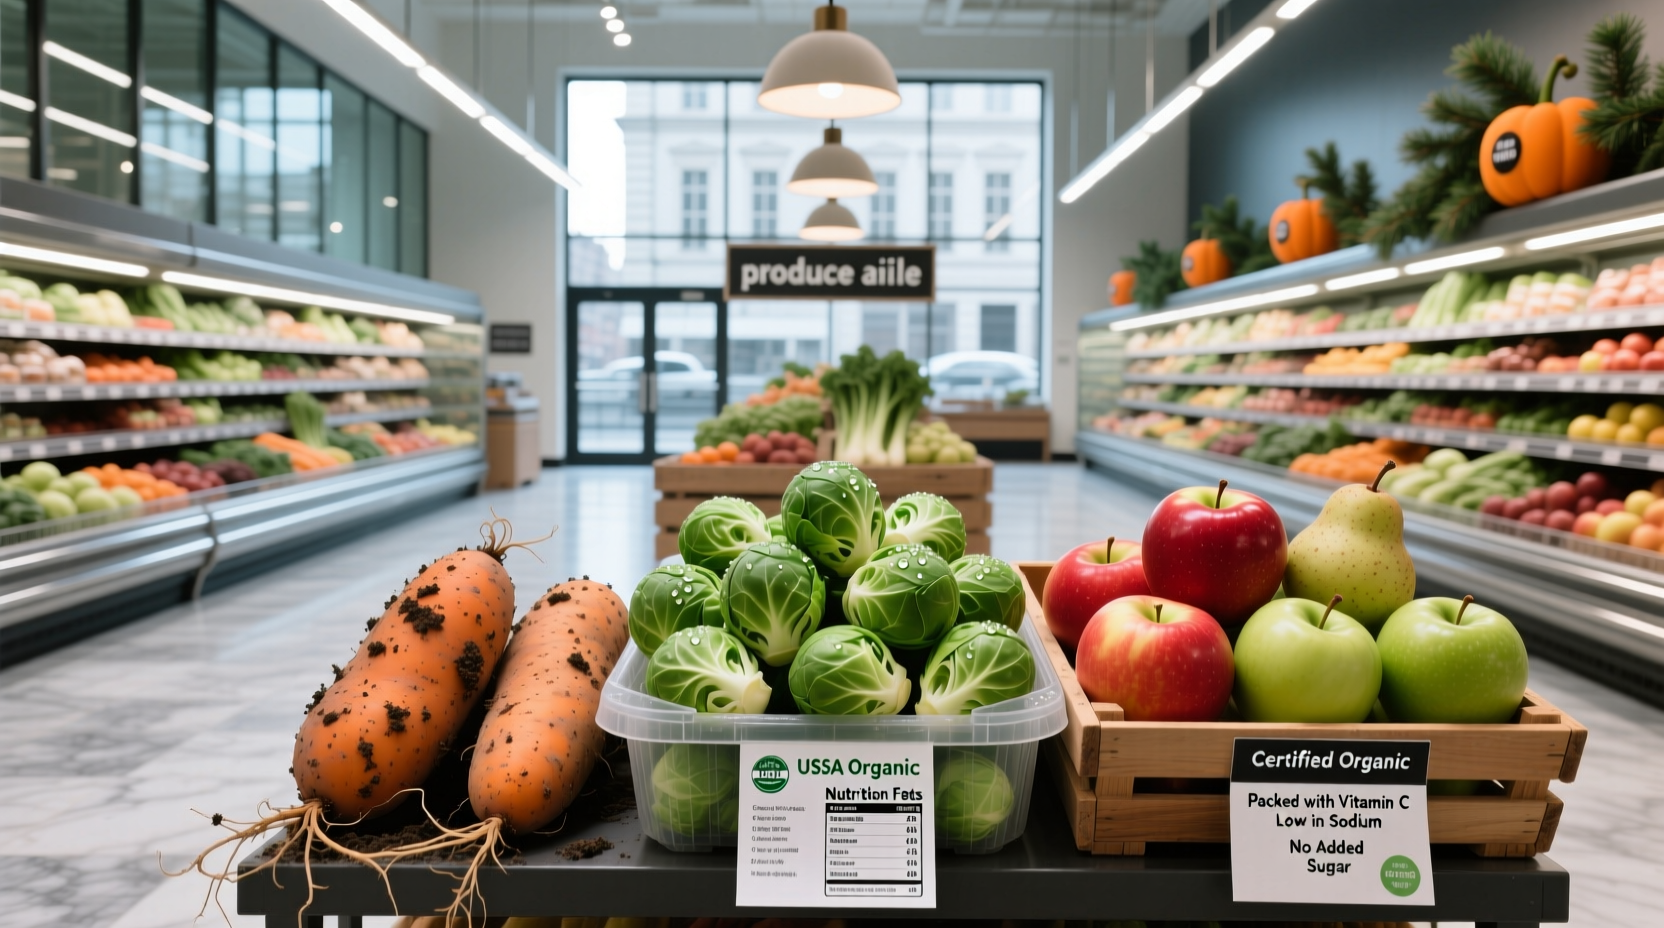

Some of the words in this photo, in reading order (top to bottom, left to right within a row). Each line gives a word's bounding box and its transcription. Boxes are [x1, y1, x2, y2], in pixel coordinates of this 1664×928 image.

[740, 256, 855, 292] produce
[861, 256, 923, 287] aiile
[797, 758, 844, 776] USSA
[848, 758, 920, 780] Organic
[1252, 749, 1334, 769] Certified
[1339, 752, 1411, 774] Organic
[1248, 792, 1299, 808] Packed
[1304, 794, 1334, 809] with
[1338, 794, 1394, 809] Vitamin
[1399, 794, 1410, 809] C
[1276, 813, 1307, 827] Low
[1312, 814, 1325, 828] in
[1329, 813, 1382, 828] Sodium
[1289, 839, 1311, 853] No
[1315, 840, 1364, 854] Added
[1307, 858, 1351, 876] Sugar
